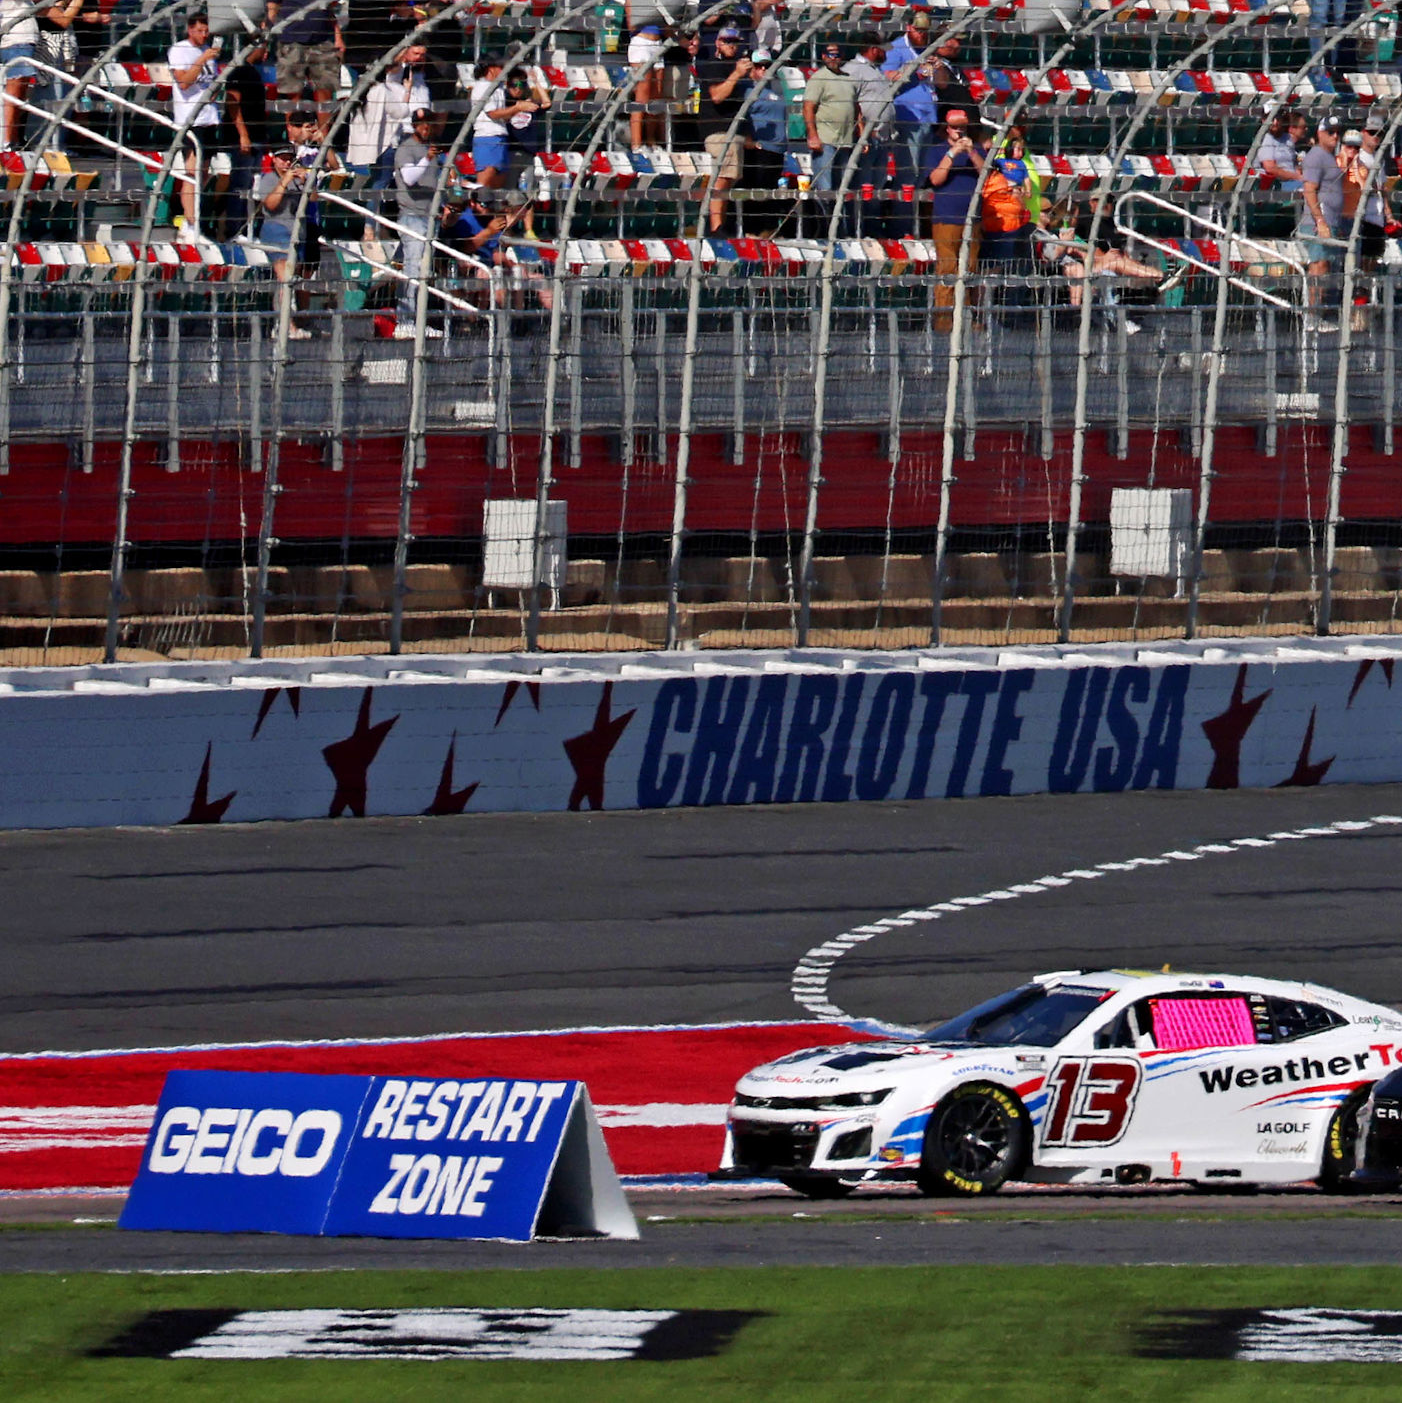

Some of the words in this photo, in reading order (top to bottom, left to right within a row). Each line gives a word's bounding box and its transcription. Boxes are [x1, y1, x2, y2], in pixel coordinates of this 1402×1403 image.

[637, 668, 1035, 809] CHARLOTTE
[1047, 664, 1191, 794] USA
[362, 1080, 569, 1143] RESTART
[1043, 1057, 1142, 1148] 13
[1257, 1122, 1272, 1134] LA
[1274, 1122, 1312, 1134] GOLF
[149, 1106, 342, 1177] GEICO
[368, 1153, 503, 1218] ZONE
